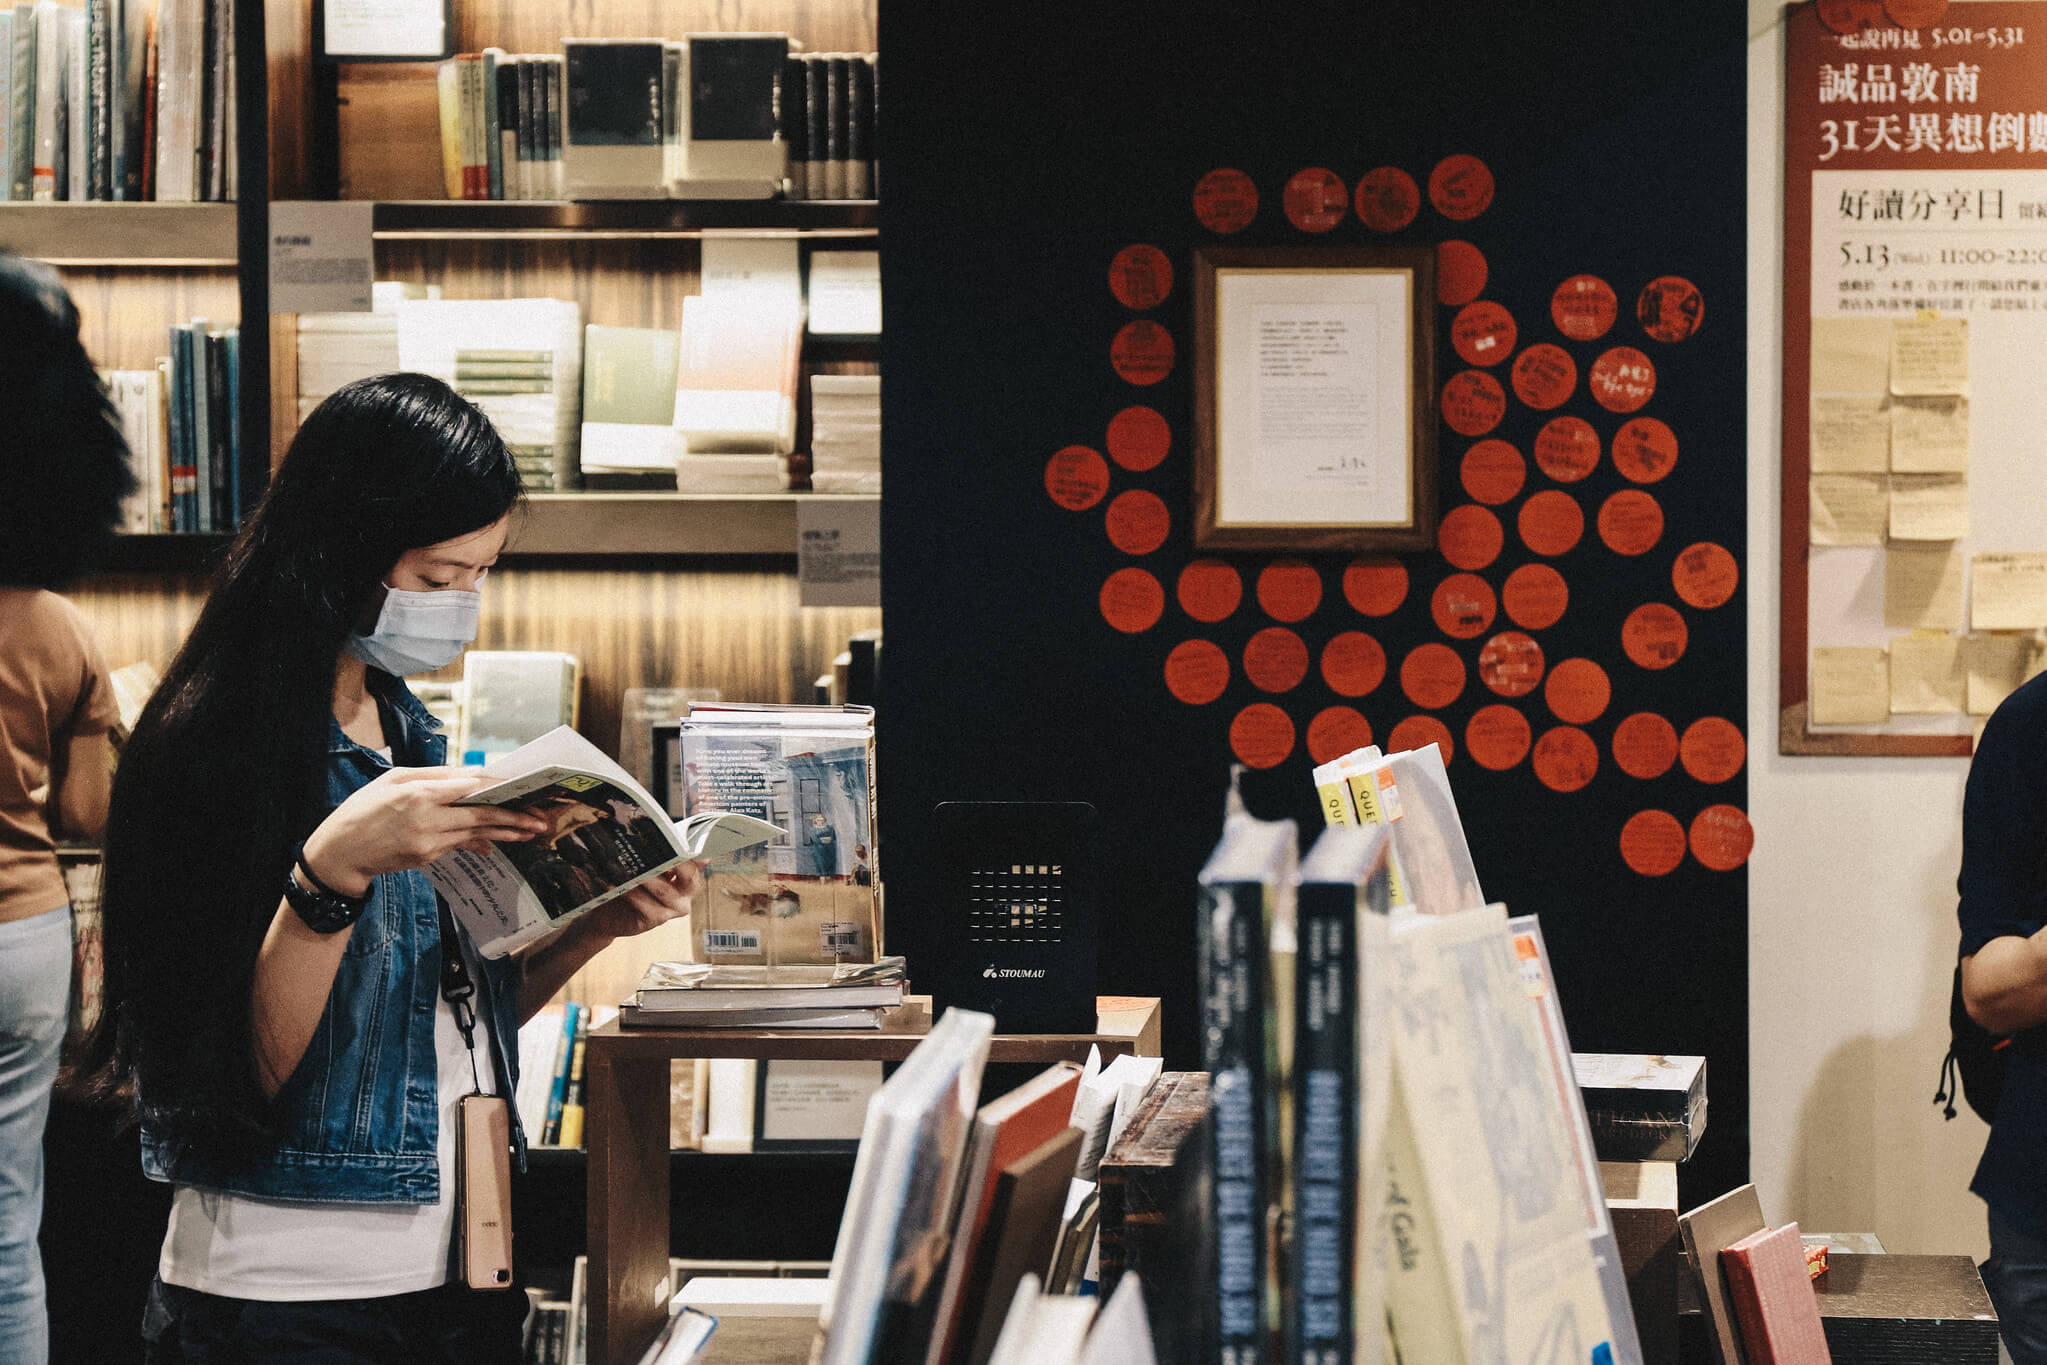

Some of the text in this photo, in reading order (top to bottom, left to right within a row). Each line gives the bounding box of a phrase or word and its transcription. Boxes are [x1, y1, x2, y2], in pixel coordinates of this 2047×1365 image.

[1818, 61, 1981, 103] 誠品敦南
[1839, 188, 2003, 220] 好讀分享日
[1840, 241, 1889, 271] 5.13
[998, 968, 1045, 978] STOUMAU
